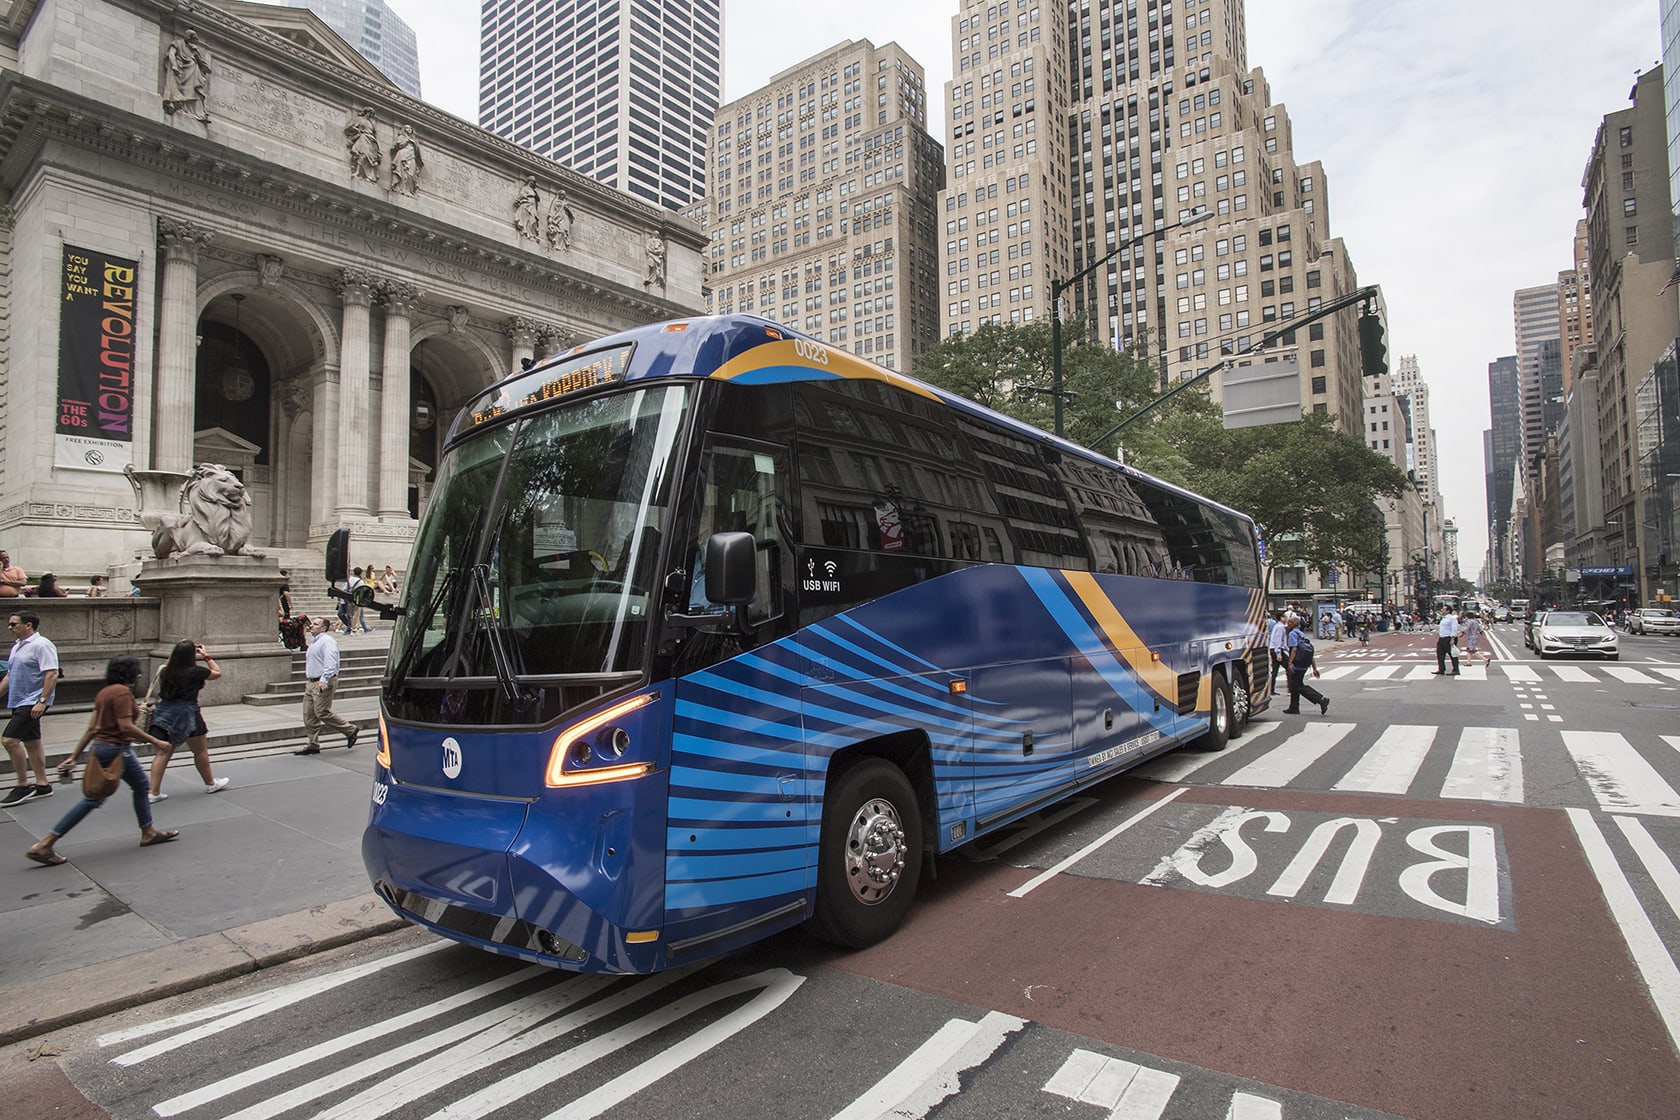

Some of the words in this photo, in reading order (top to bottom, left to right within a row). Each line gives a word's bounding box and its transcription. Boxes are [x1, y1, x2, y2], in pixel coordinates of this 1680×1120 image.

[219, 64, 243, 81] THE
[250, 80, 289, 102] ASTOR
[168, 182, 260, 216] MDCCCXCV
[67, 254, 89, 266] YOU
[66, 264, 87, 275] SAY
[304, 221, 348, 246] THE
[363, 239, 409, 263] NEW
[424, 258, 467, 282] YORK
[479, 277, 532, 300] PUBLIC
[543, 294, 598, 319] LIBRARY
[67, 273, 88, 285] YOU
[66, 283, 99, 297] WANT
[66, 293, 74, 301] A
[98, 261, 134, 433] REVOLUTION
[794, 338, 829, 365] 0023
[61, 403, 87, 416] THE
[60, 414, 88, 428] 60s
[84, 439, 123, 448] EXHIBITION
[803, 580, 821, 591] USB
[822, 580, 840, 592] WIFI
[442, 746, 459, 769] MTA
[1174, 808, 1502, 925] BUS
